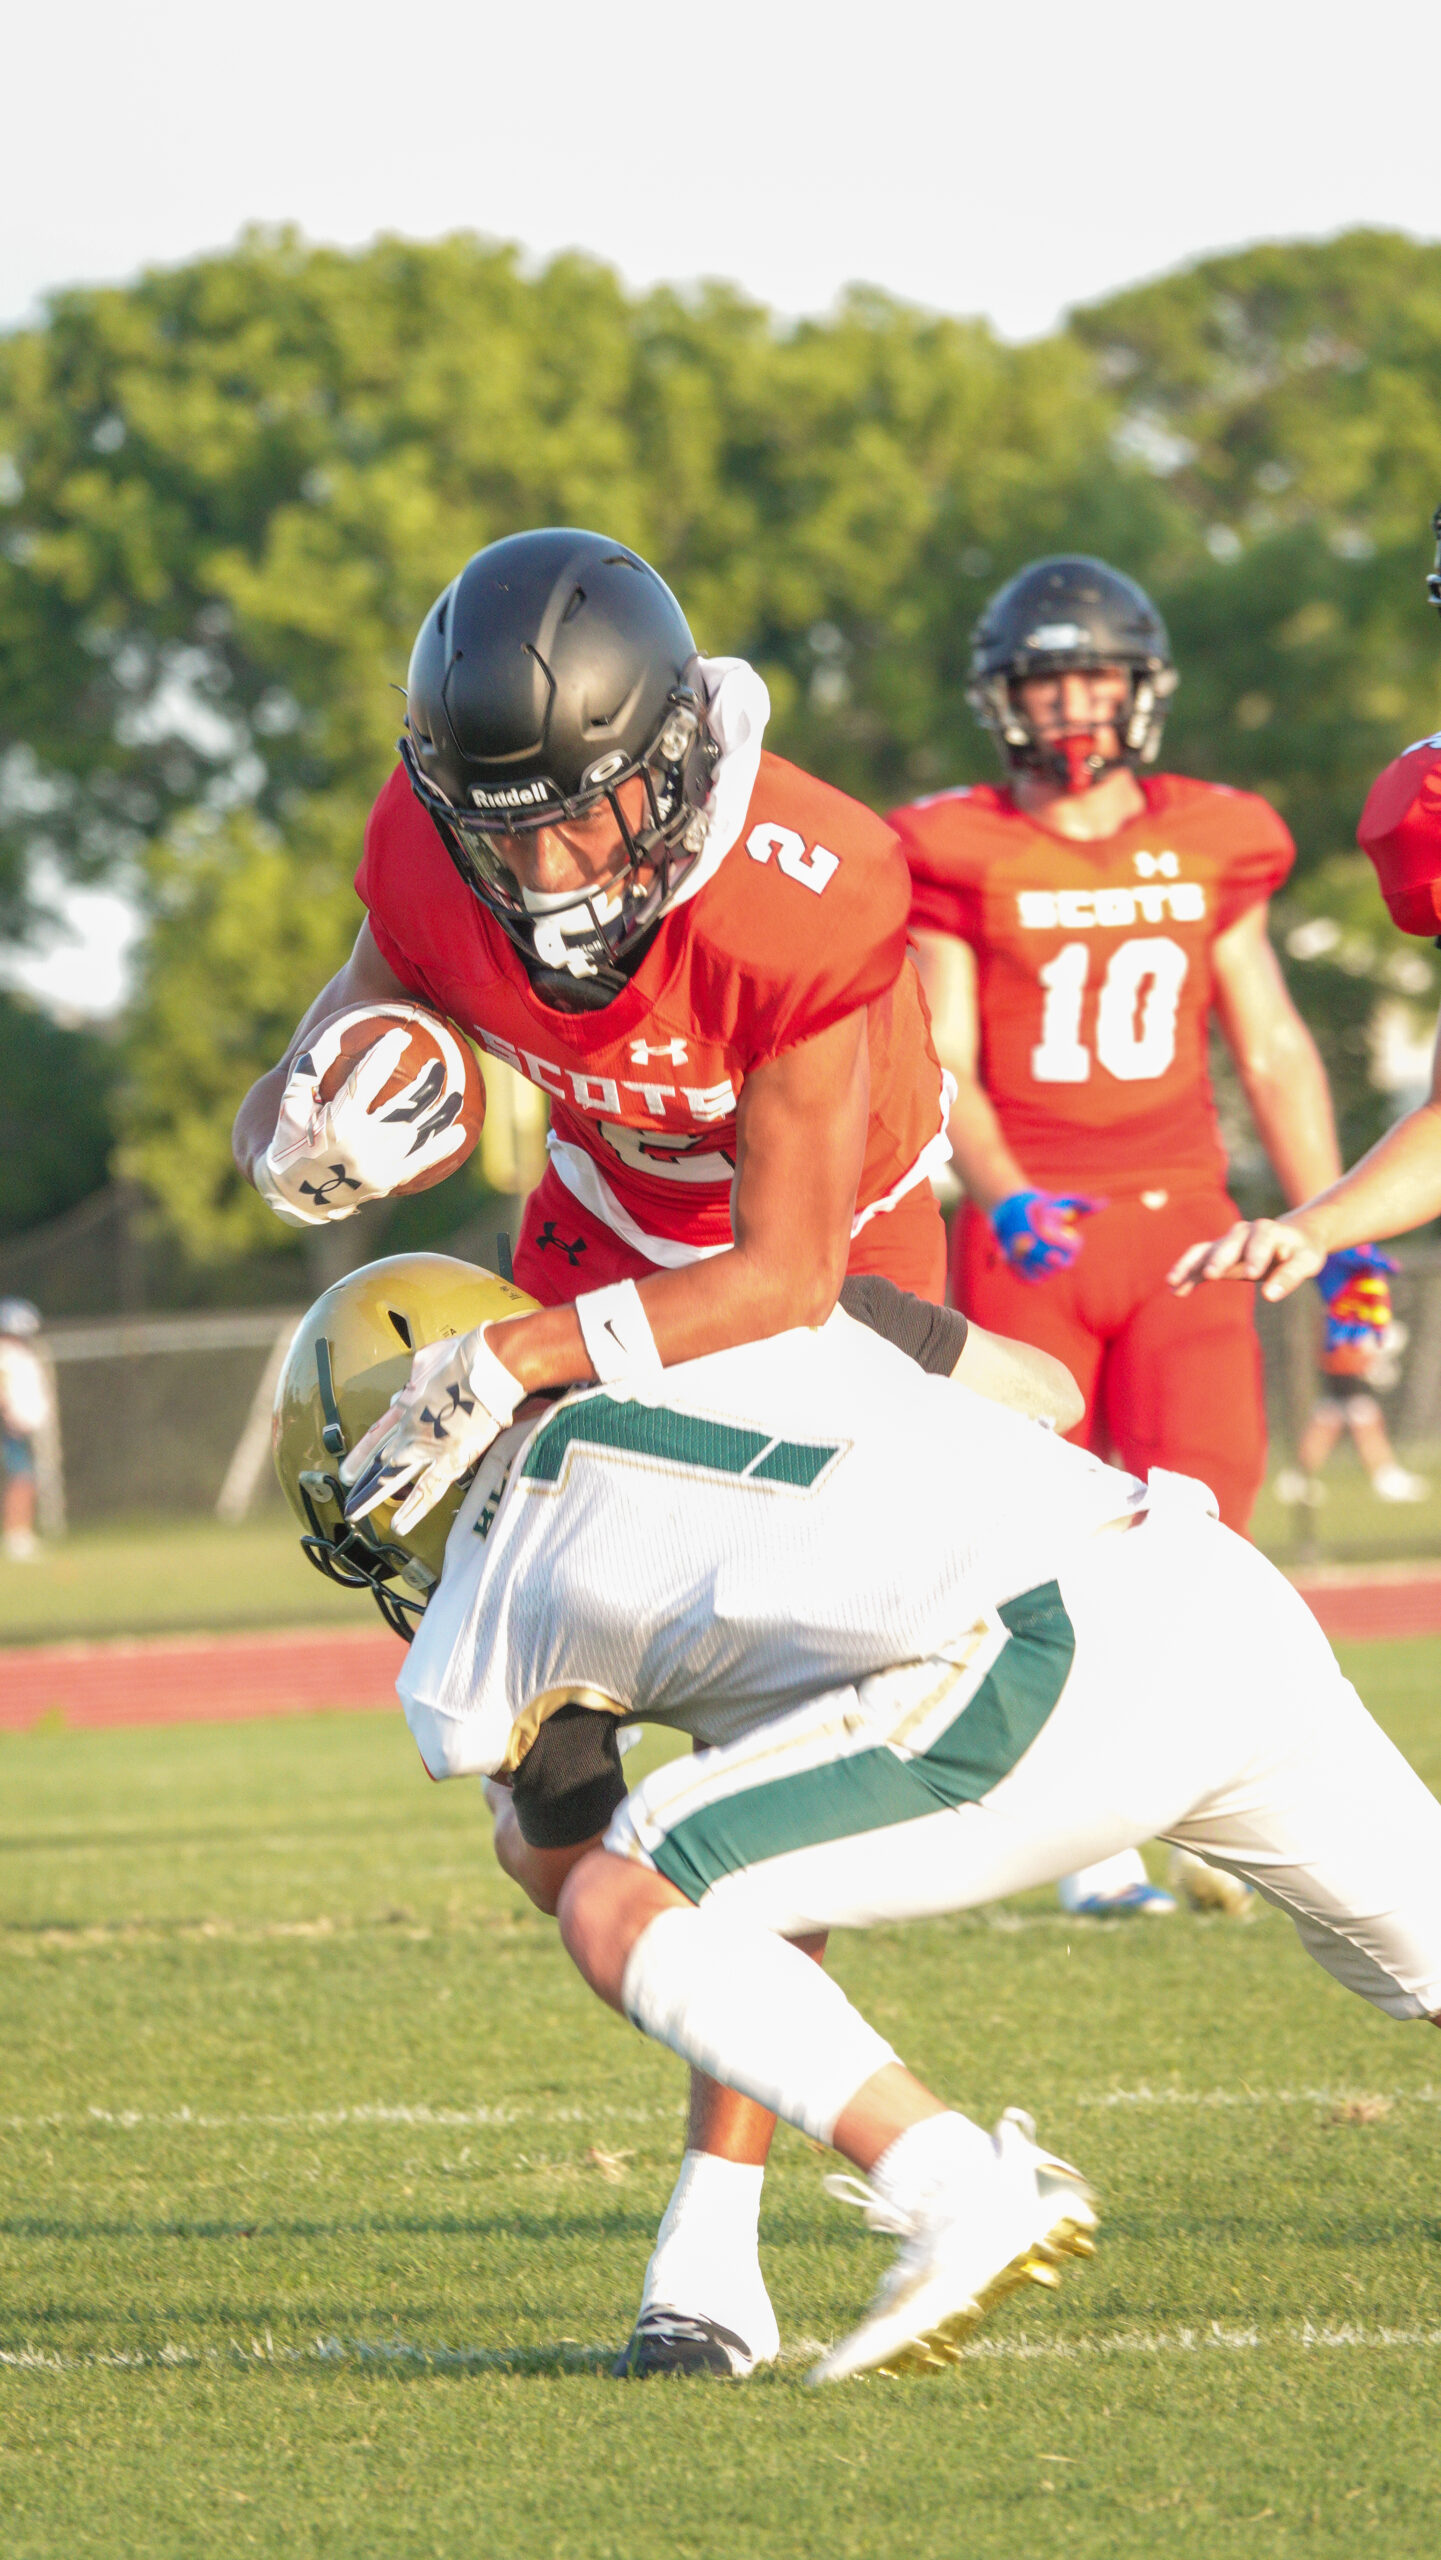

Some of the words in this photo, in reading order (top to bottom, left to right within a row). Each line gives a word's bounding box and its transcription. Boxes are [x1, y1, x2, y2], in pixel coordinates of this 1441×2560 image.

[471, 781, 550, 809] Riddell
[745, 821, 841, 896] 2
[1016, 882, 1206, 928] SCOTS
[1031, 936, 1189, 1084] 10
[473, 1024, 737, 1122] SCOTS
